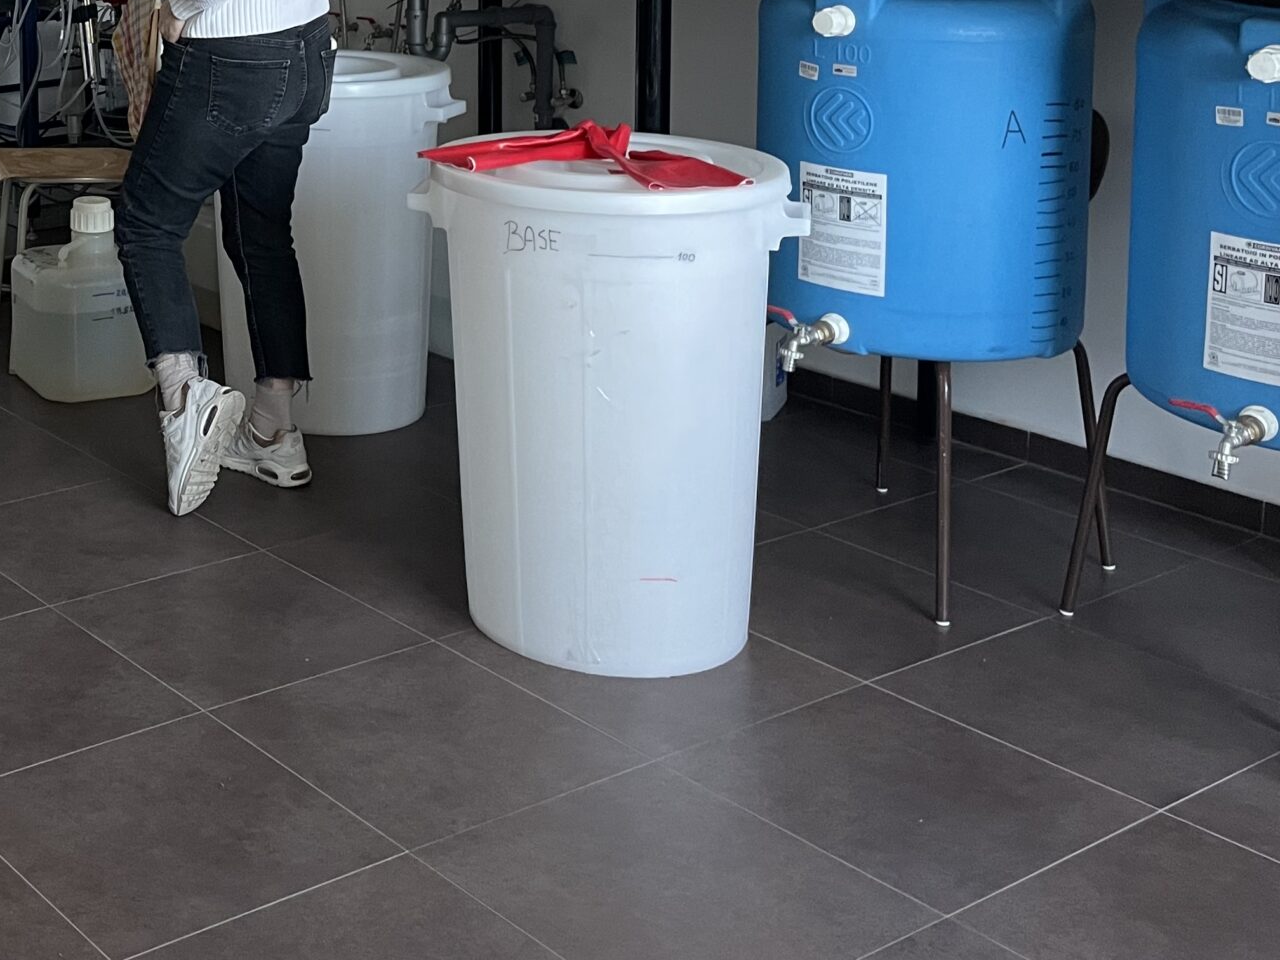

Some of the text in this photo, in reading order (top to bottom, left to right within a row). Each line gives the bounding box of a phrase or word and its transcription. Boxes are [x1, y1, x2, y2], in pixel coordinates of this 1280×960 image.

[1002, 110, 1026, 149] A
[503, 220, 561, 254] BASE
[1220, 244, 1257, 256] SERBATOIO
[1214, 264, 1227, 292] SI
